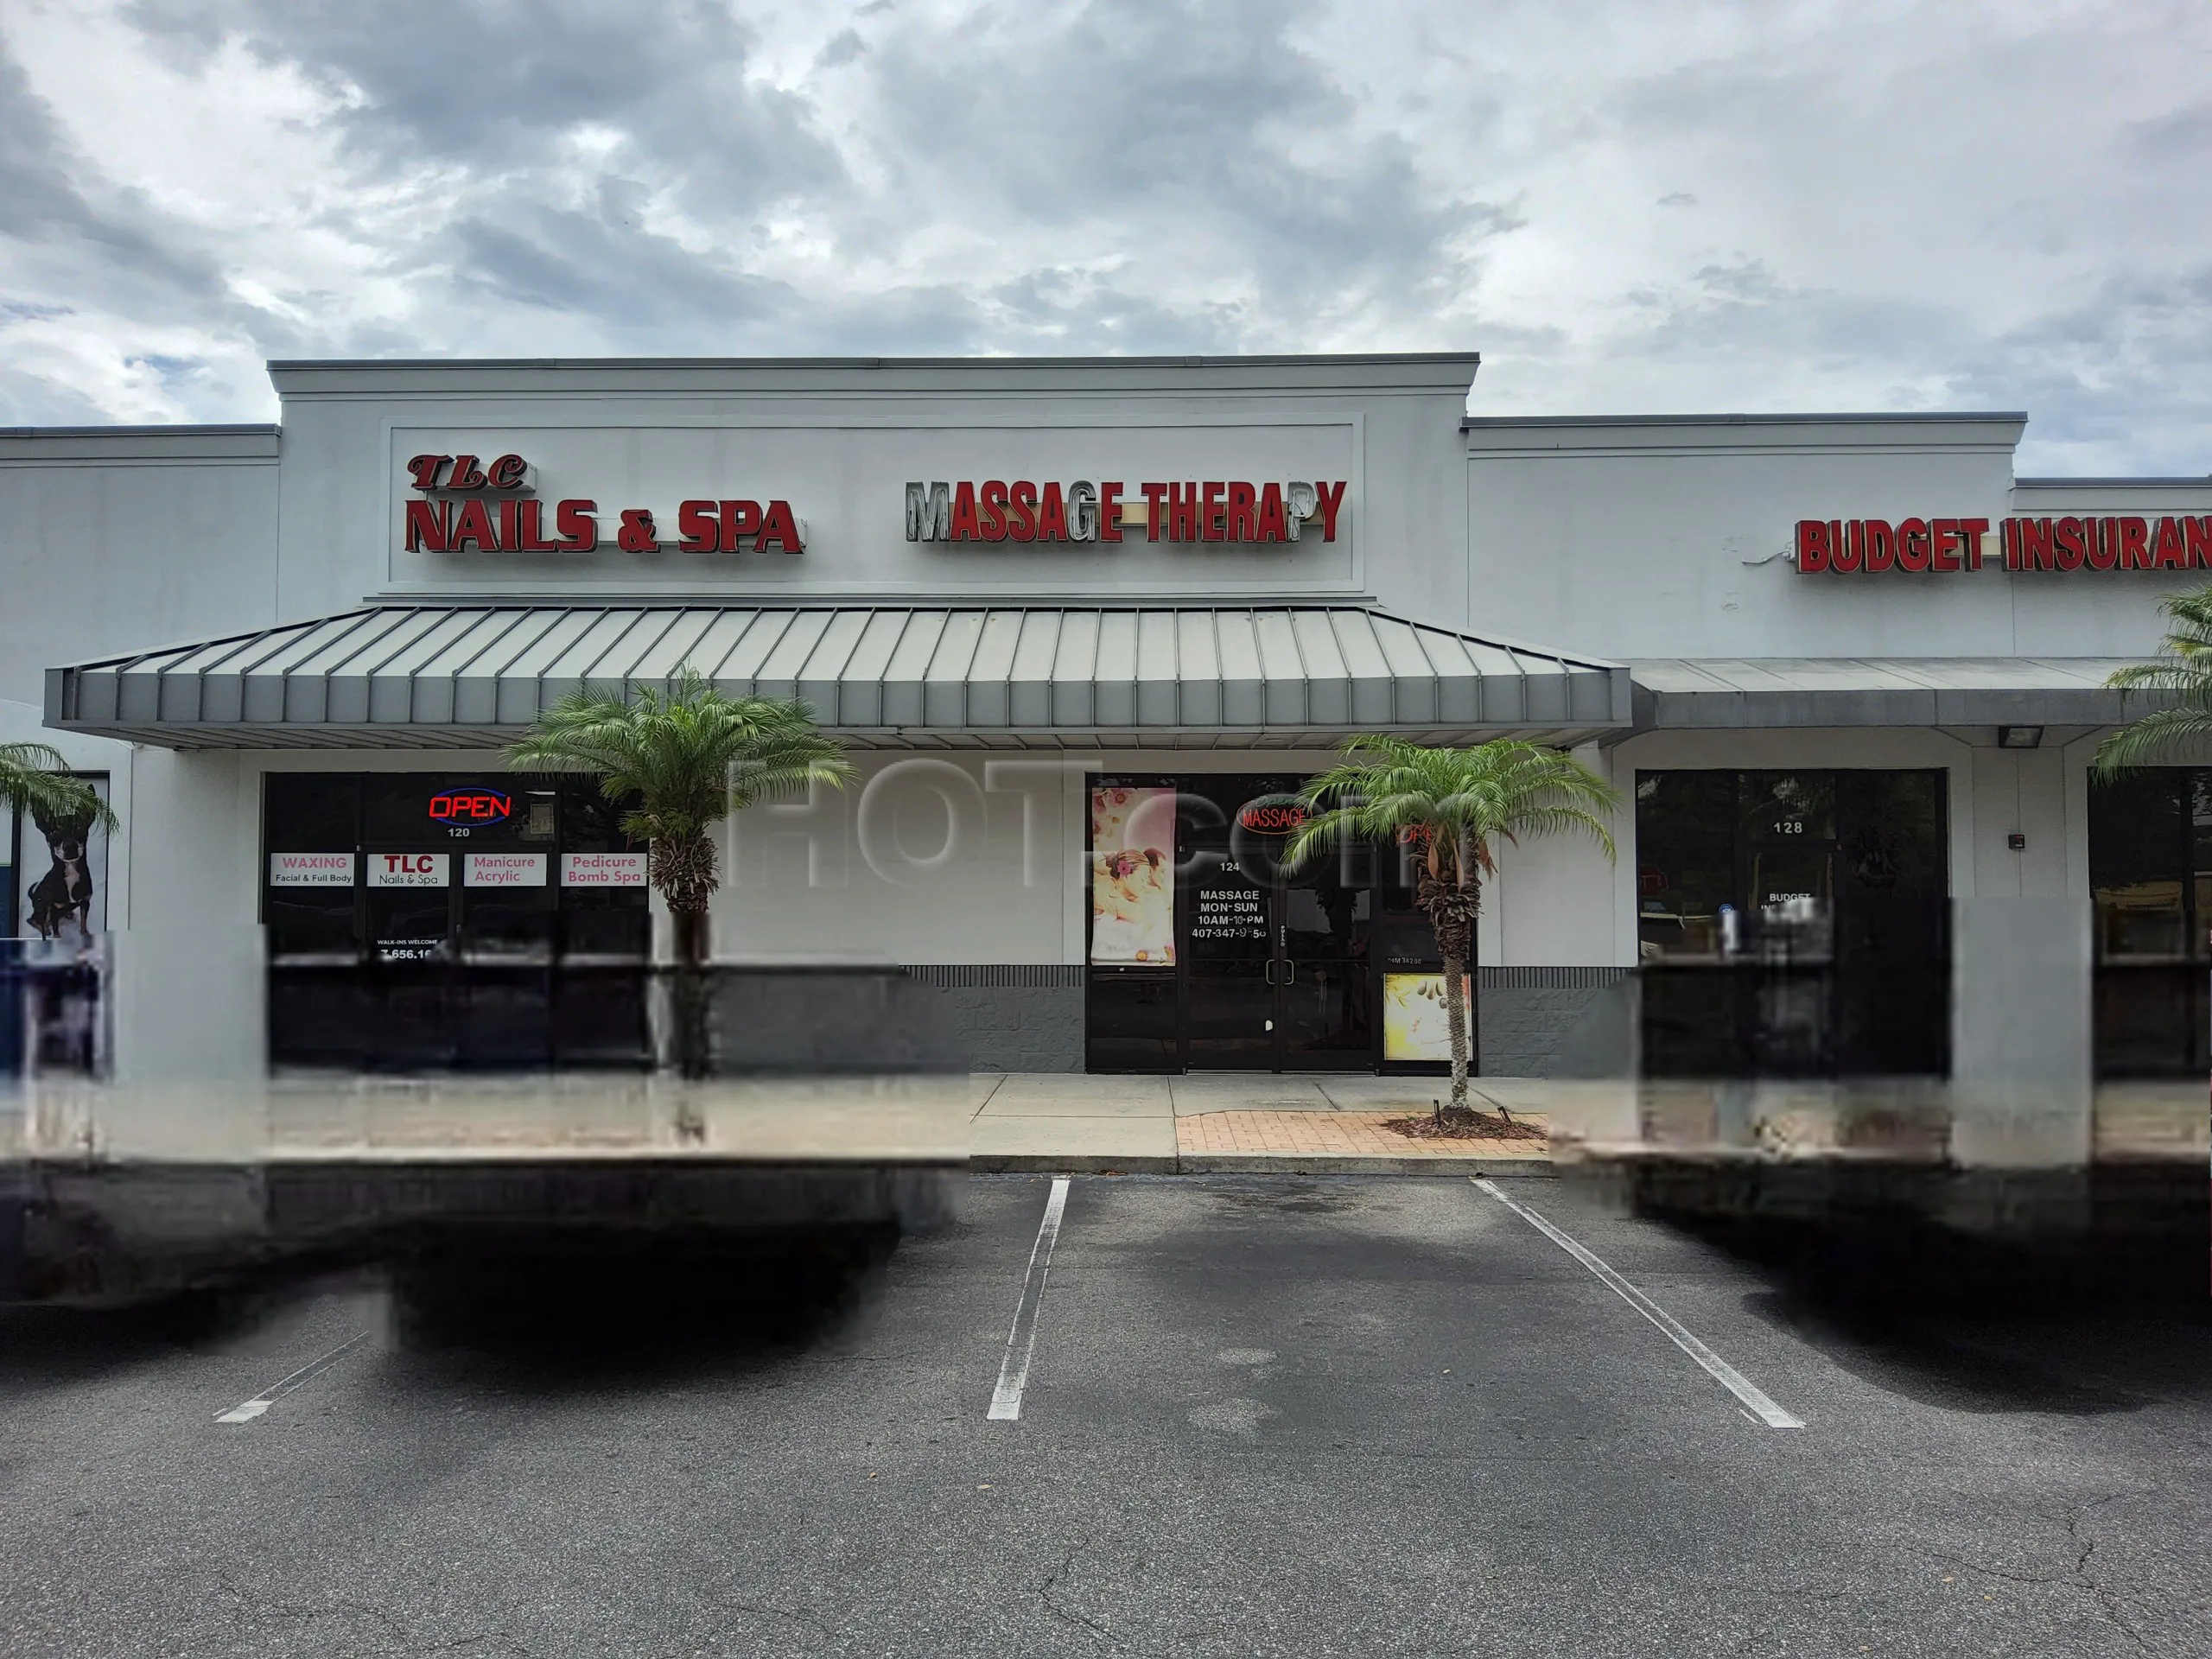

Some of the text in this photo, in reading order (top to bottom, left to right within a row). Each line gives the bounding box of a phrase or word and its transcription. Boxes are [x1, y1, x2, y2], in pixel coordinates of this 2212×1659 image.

[407, 454, 528, 490] TLC
[906, 481, 1346, 543] MASSAGE THERAPY
[404, 499, 804, 554] NAILS & SPA
[1795, 517, 1989, 574] BUDGET
[429, 796, 512, 817] OPEN
[1243, 808, 1307, 827] MASSAGE
[448, 828, 470, 837] 120
[1773, 822, 1803, 834] 128
[282, 857, 347, 869] WAXING
[384, 855, 434, 874] TLC
[474, 856, 536, 868] Manicure
[572, 855, 637, 868] Pedicure
[1220, 862, 1240, 872] 124
[276, 874, 301, 882] Facial
[312, 874, 327, 882] Full
[330, 874, 352, 884] Body
[378, 874, 438, 886] Nails & Spa
[474, 871, 520, 884] Acrylic
[569, 871, 641, 885] Bomb Spa
[1200, 890, 1260, 899] MASSAGE
[1200, 903, 1258, 912] MON-SUN
